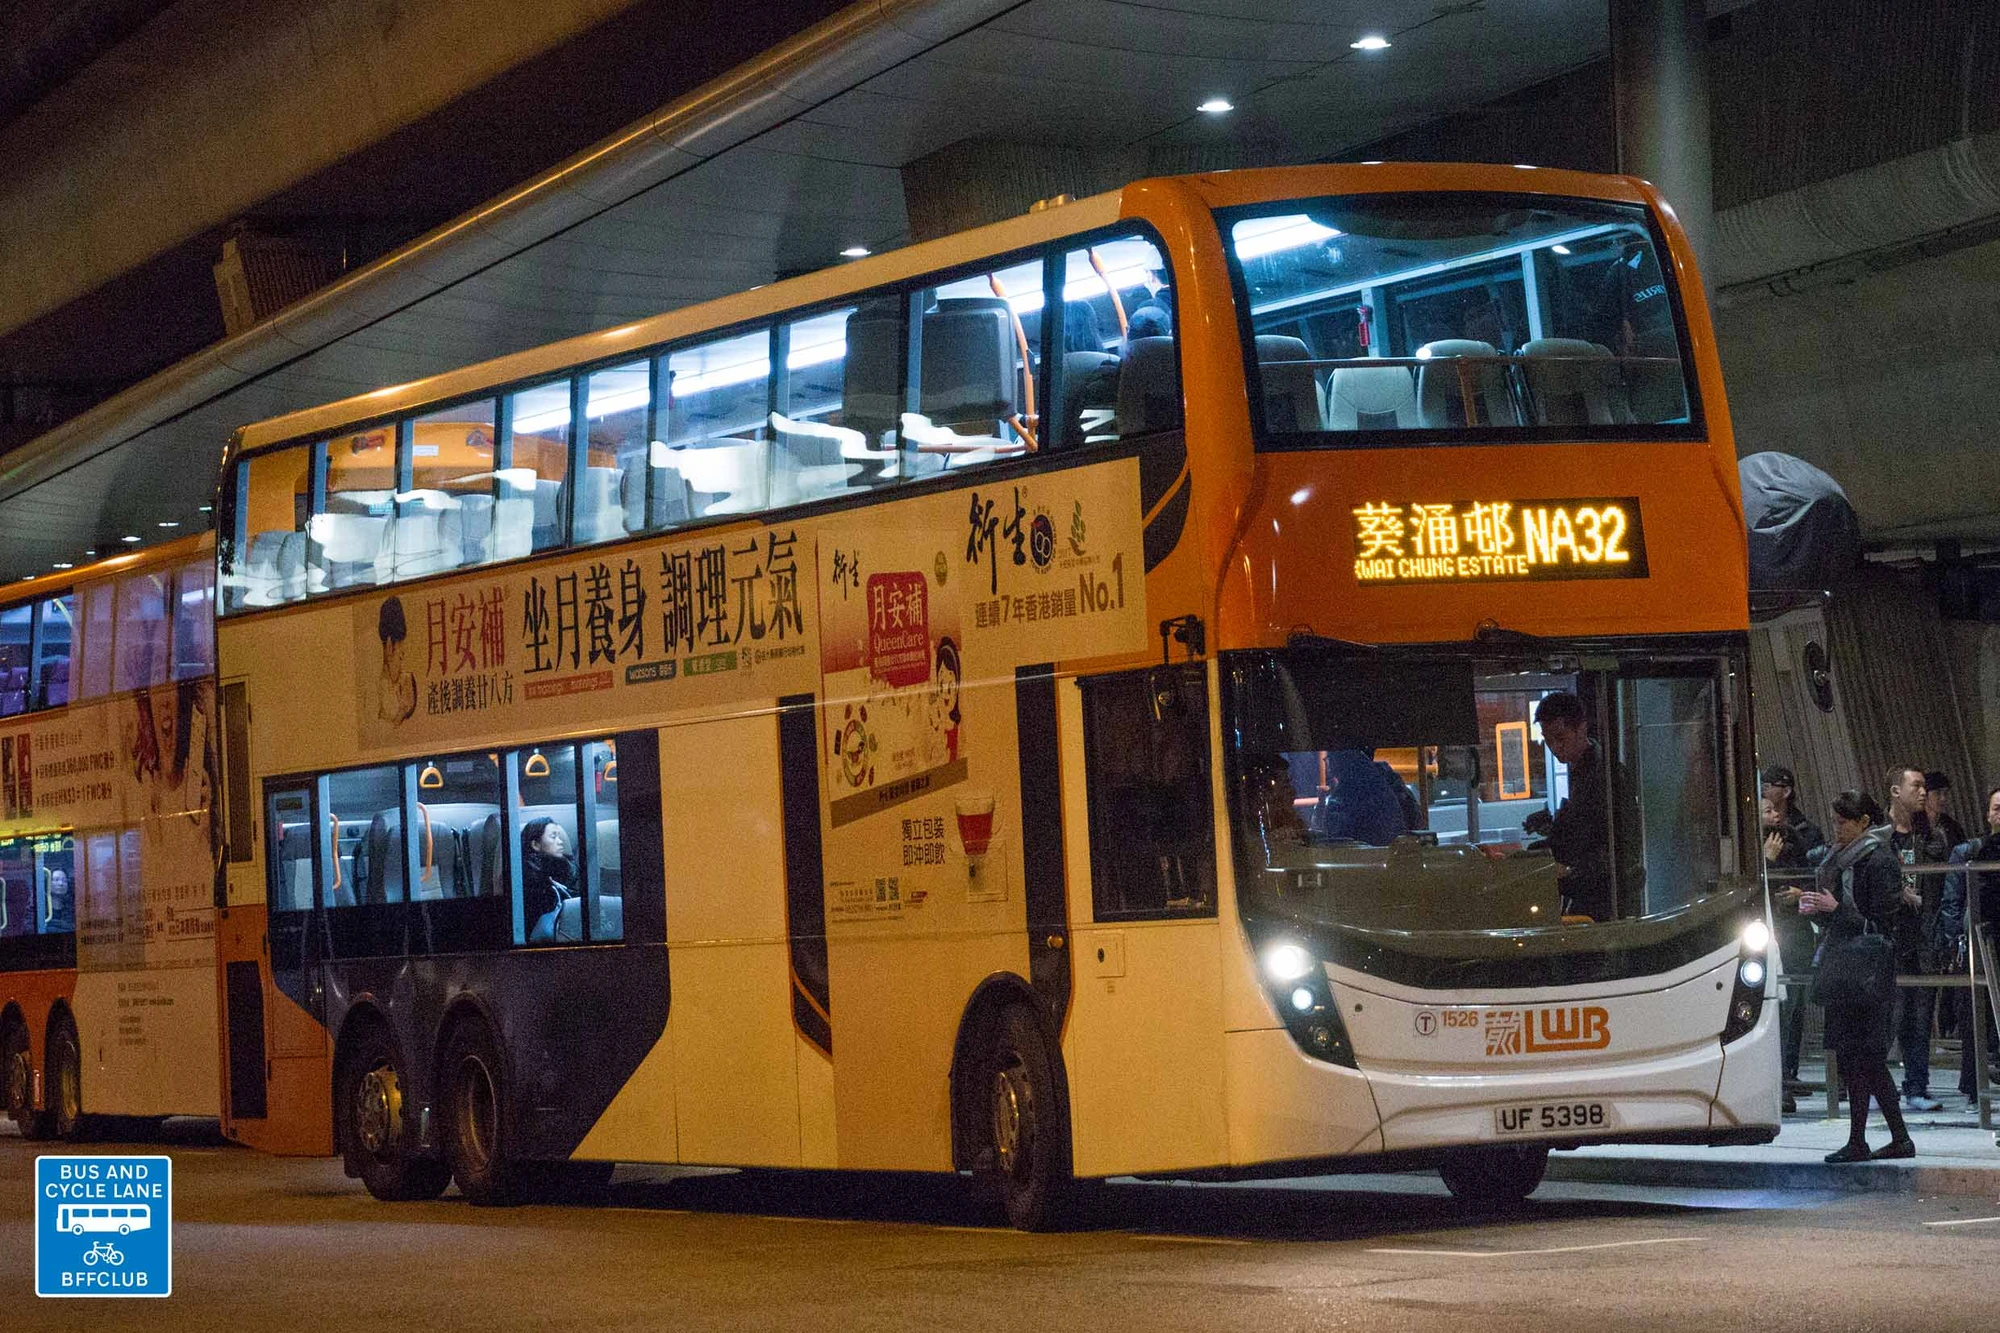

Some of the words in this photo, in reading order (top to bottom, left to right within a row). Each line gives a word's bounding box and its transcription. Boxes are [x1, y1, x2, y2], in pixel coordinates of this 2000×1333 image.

[1353, 501, 1516, 557] 葵涌邨
[1522, 506, 1630, 564] NA32
[1079, 552, 1125, 614] No.1
[1399, 557, 1455, 578] CHUNG
[1458, 554, 1529, 576] ESTATE
[523, 559, 648, 675] 坐月養身
[660, 529, 804, 655] 調理元氣
[872, 583, 924, 631] 月安補
[425, 587, 505, 677] 月安補
[873, 631, 925, 654] QueenCare
[427, 671, 513, 715] 產後調養廿八方
[901, 816, 945, 841] 獨立包裝
[903, 843, 945, 866] 即沖即飲
[1441, 1011, 1478, 1027] 1526
[1524, 1006, 1611, 1053] LWB
[1502, 1108, 1532, 1130] UF
[1541, 1104, 1603, 1127] 5398
